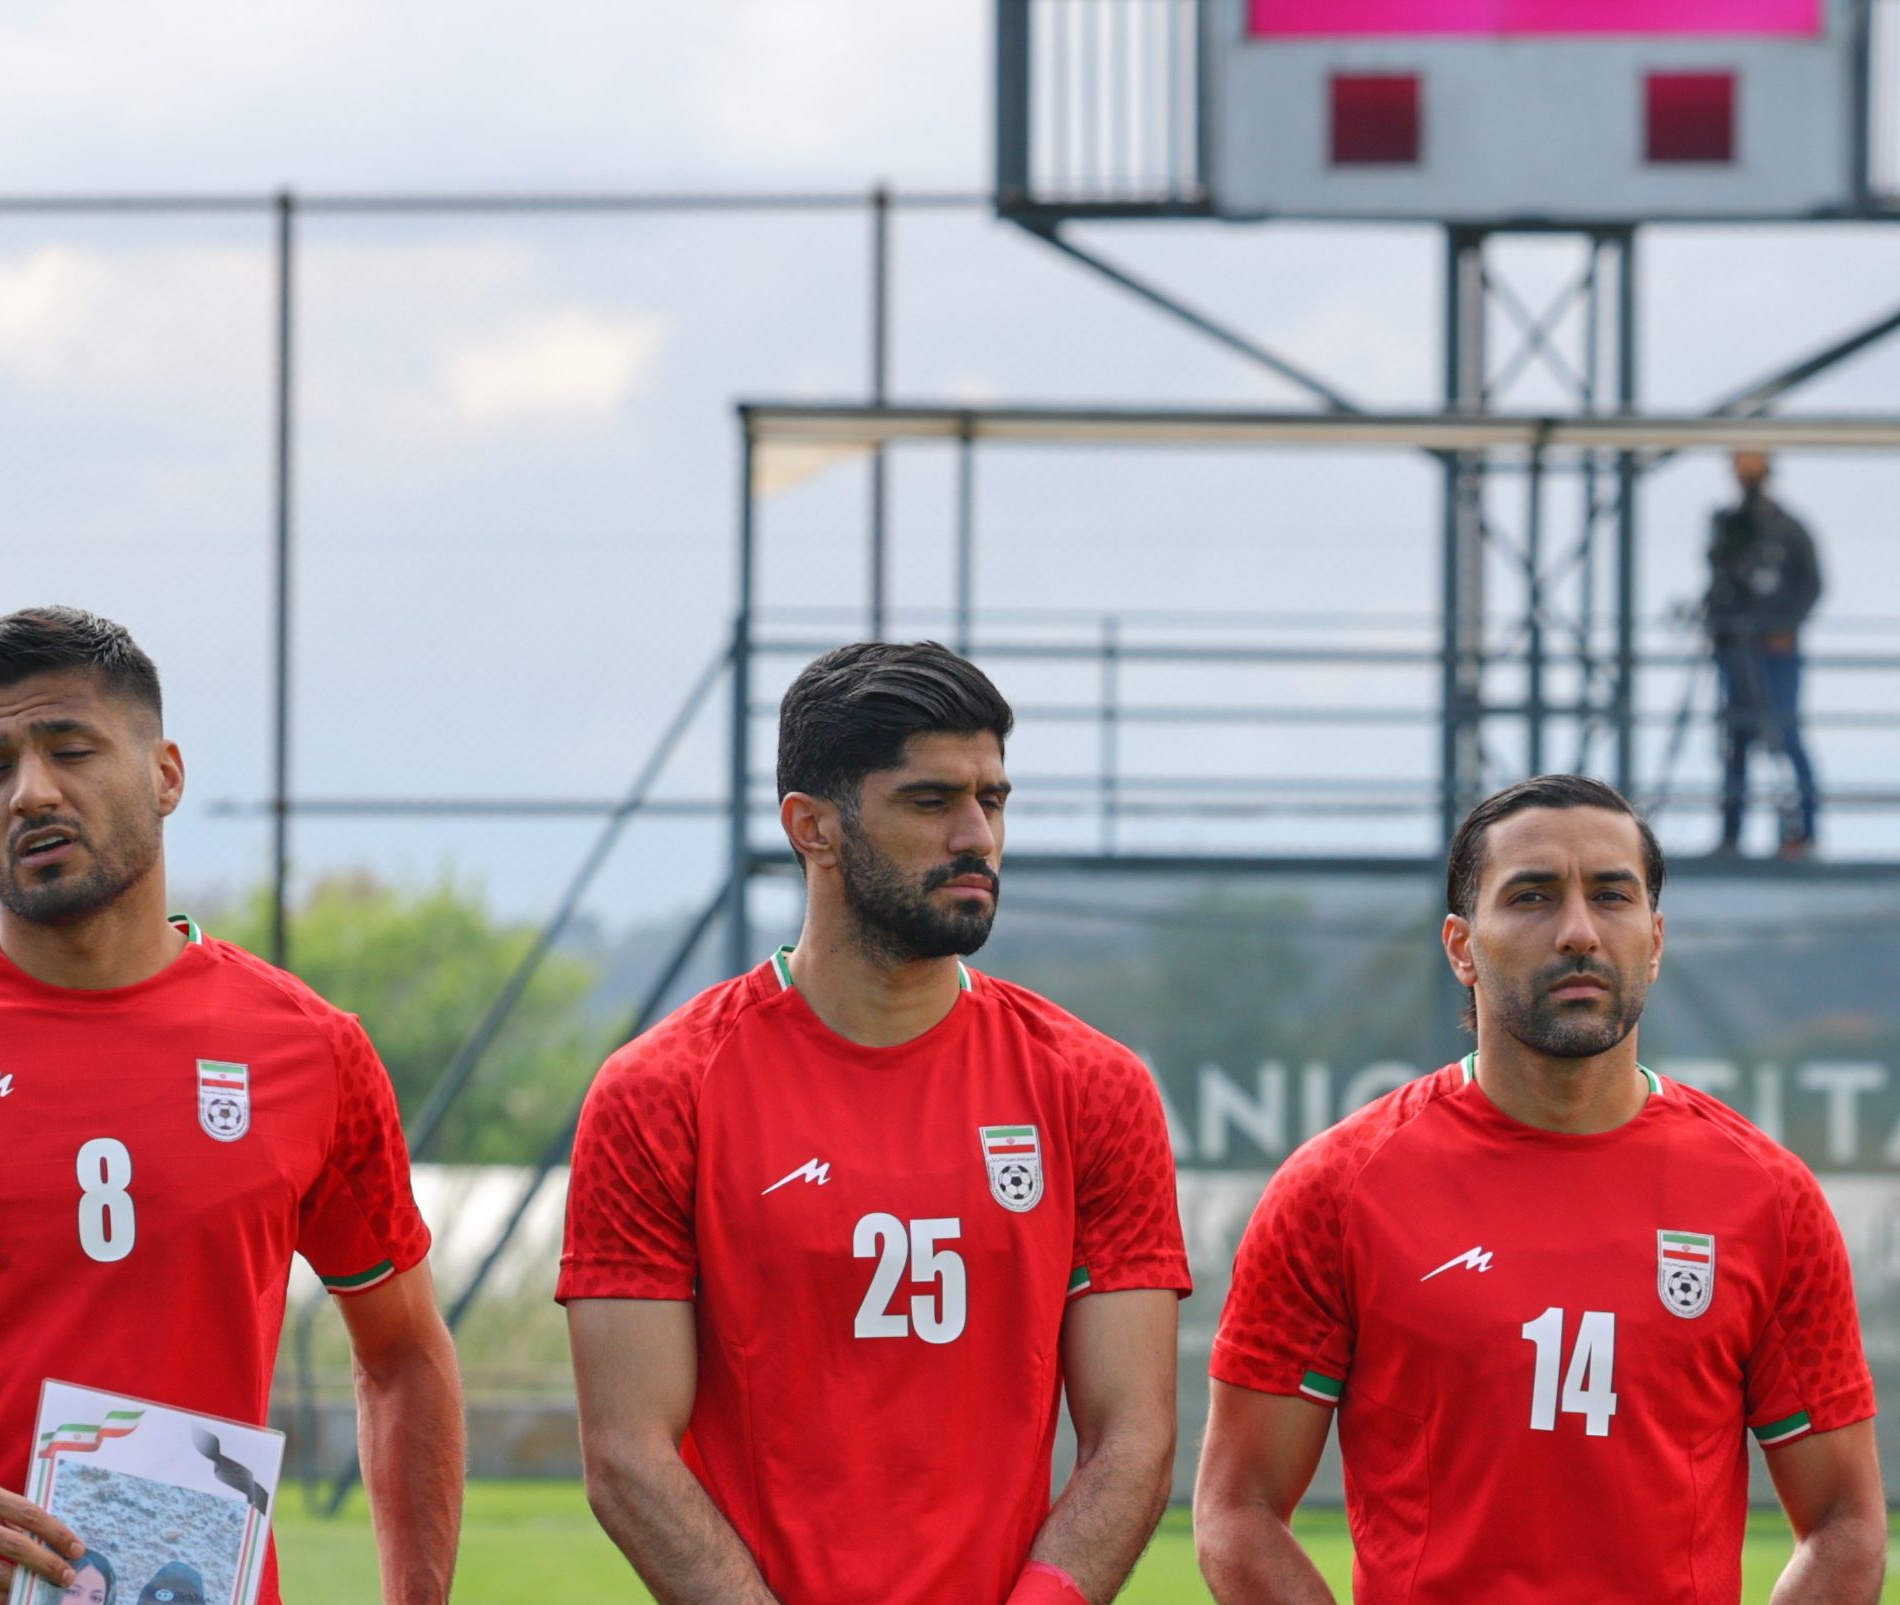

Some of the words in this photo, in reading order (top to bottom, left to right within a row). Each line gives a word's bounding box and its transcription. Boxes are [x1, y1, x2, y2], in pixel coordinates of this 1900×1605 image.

[76, 1137, 136, 1262] 8
[851, 1212, 968, 1345] 25
[1520, 1306, 1618, 1438] 14
